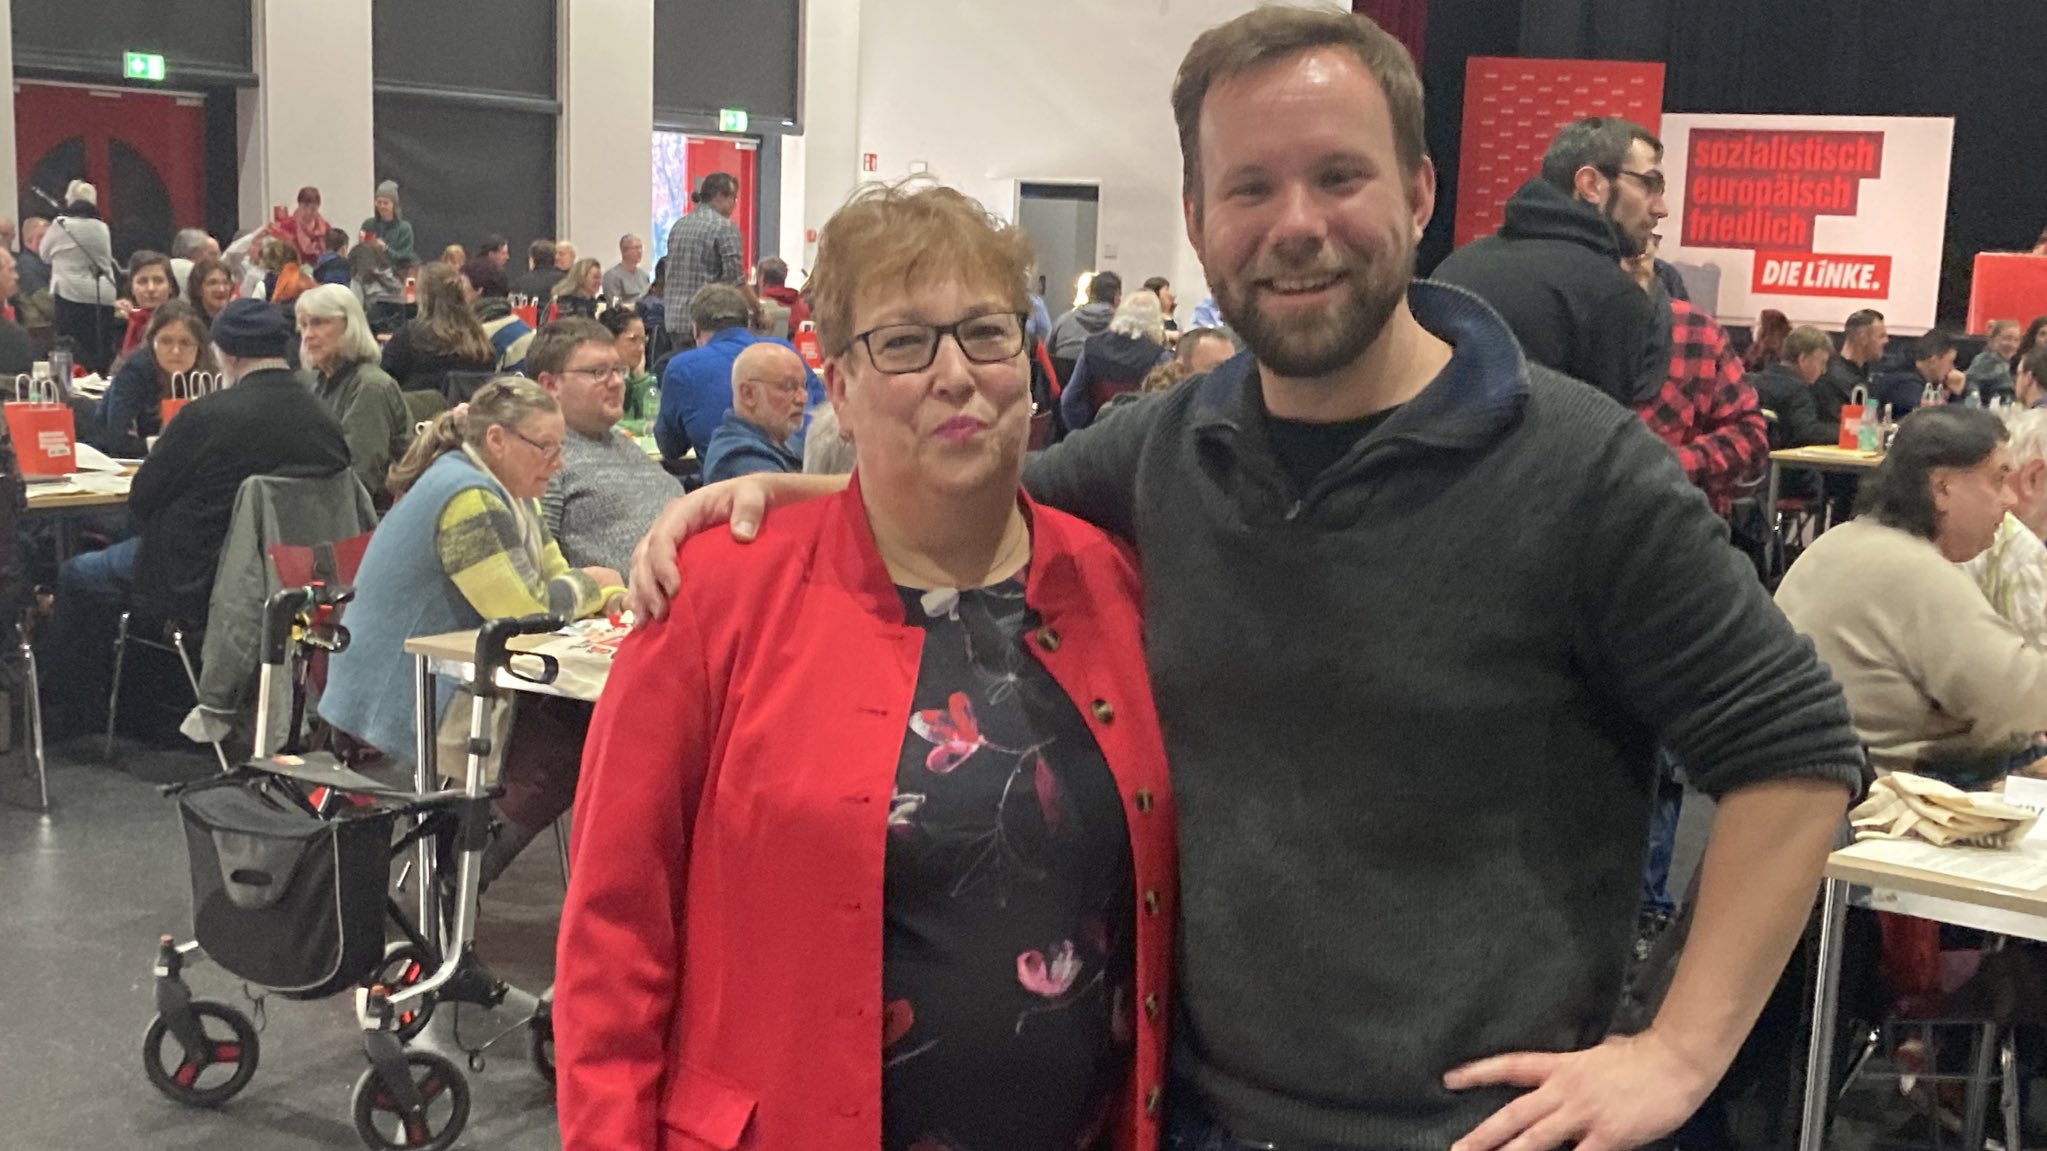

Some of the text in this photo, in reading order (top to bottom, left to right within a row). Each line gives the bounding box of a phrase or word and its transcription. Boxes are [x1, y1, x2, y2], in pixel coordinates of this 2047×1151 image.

[1694, 135, 1875, 171] sozialistisch
[1691, 173, 1851, 209] europäisch
[1689, 207, 1807, 245] friedlich
[1761, 260, 1803, 287] DIE
